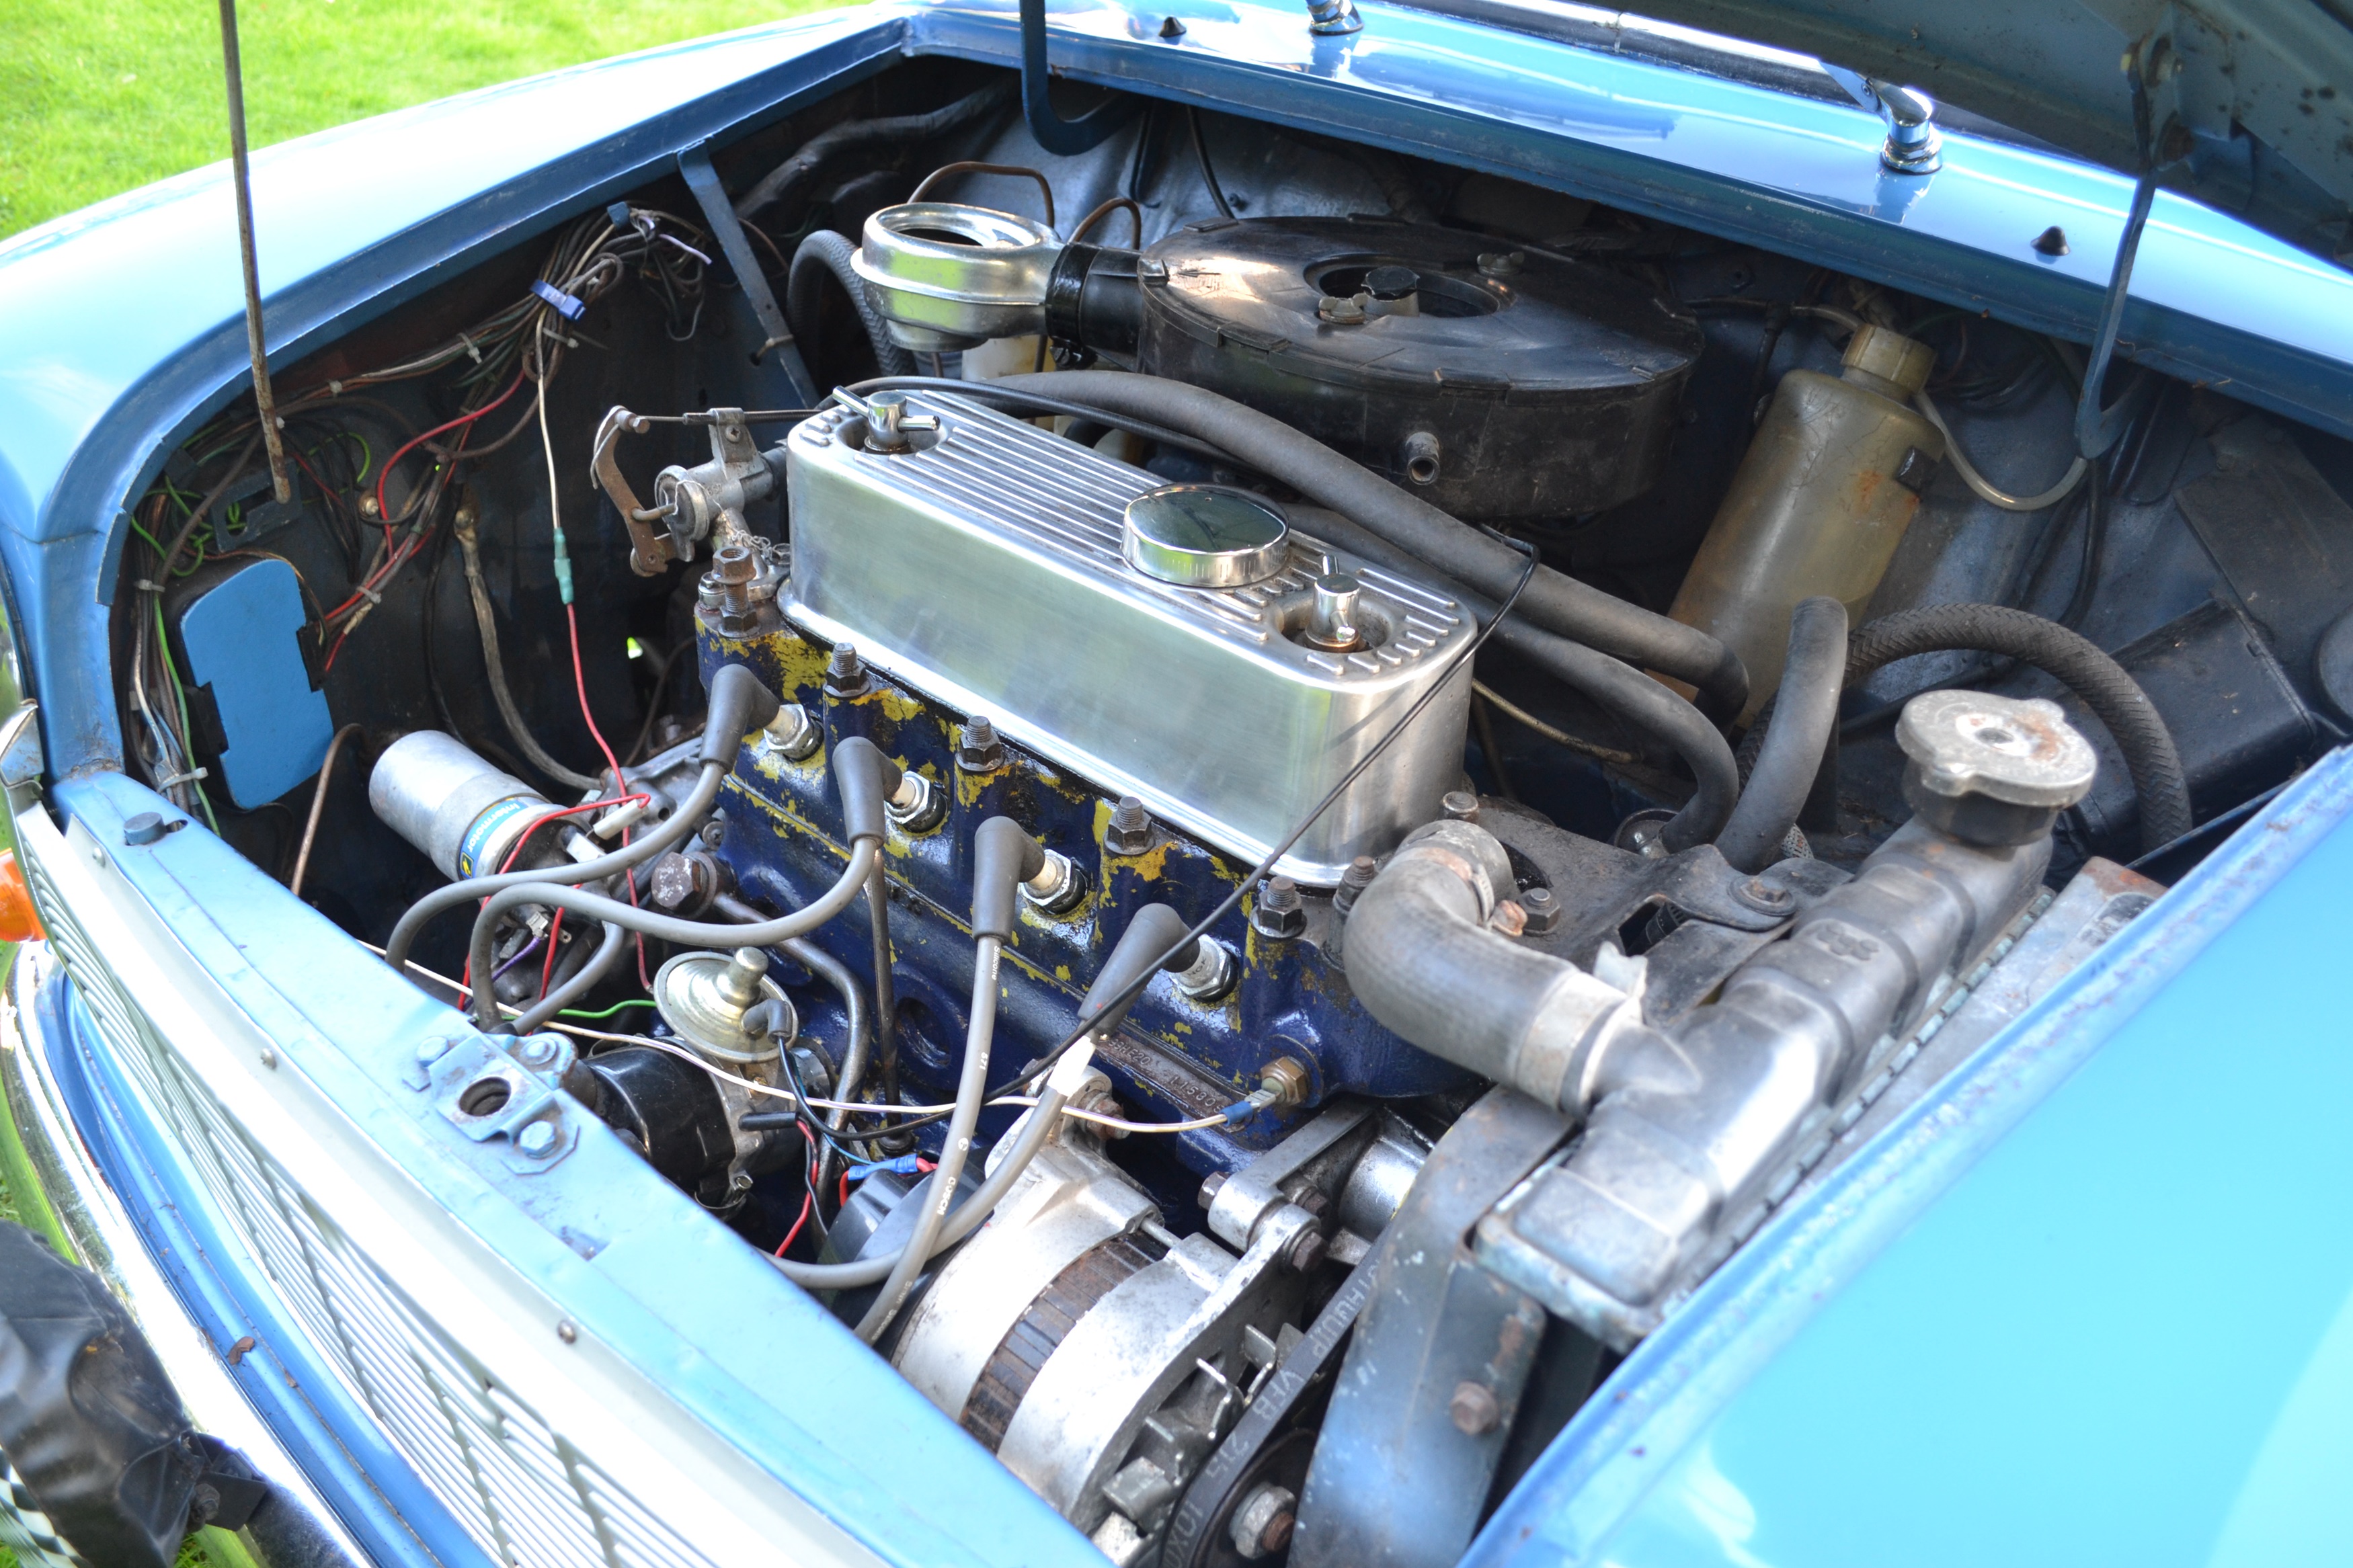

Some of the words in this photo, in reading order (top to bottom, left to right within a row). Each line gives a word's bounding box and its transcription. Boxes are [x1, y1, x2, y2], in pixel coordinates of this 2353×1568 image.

[467, 803, 520, 852] Intermotor
[991, 945, 1000, 981] Silicone
[1187, 956, 1206, 976] NGK
[1252, 1368, 1303, 1421] VFB
